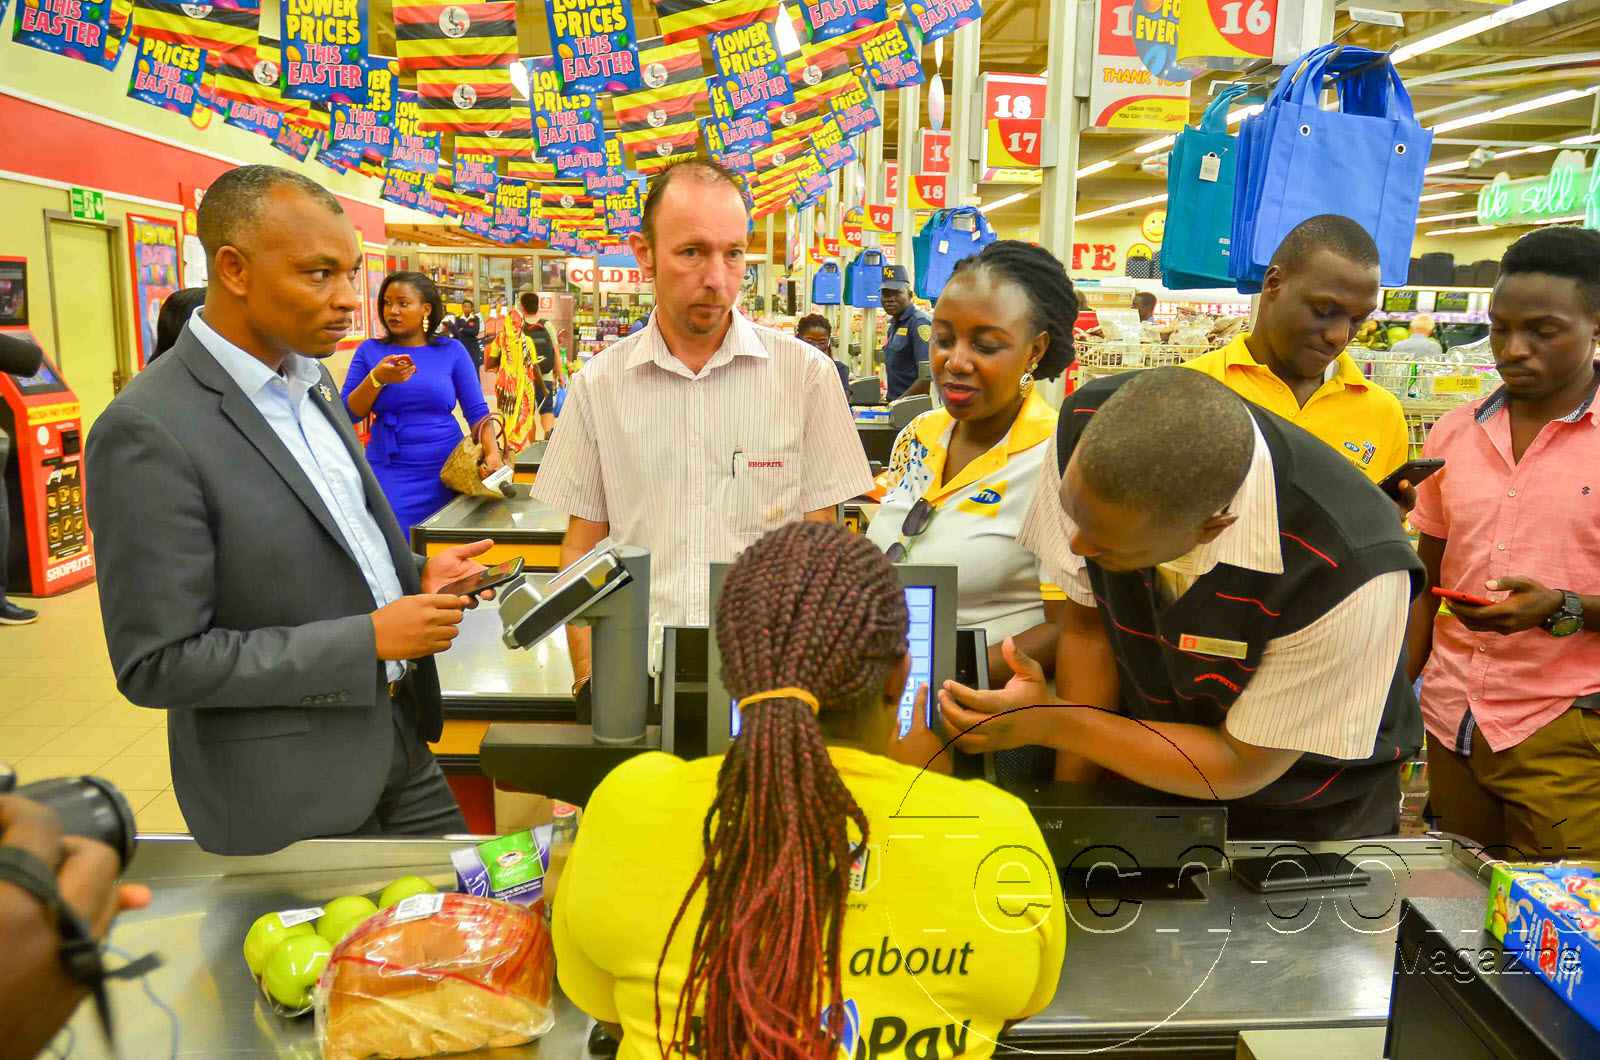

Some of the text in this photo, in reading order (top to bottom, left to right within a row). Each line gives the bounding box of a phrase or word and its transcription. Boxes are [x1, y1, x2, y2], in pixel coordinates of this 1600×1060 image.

[288, 0, 359, 18] LOWER
[1220, 1, 1271, 35] 16
[22, 6, 101, 48] EASTER
[286, 14, 361, 44] PRICES
[553, 6, 627, 37] PRICES
[575, 34, 612, 55] THIS
[715, 21, 771, 58] LOWER
[863, 37, 908, 65] PRICES
[142, 37, 201, 72] PRICES
[304, 43, 342, 64] THIS
[719, 42, 777, 76] PRICES
[153, 60, 181, 83] THIS
[287, 61, 363, 89] EASTER
[562, 51, 635, 82] EASTER
[738, 66, 768, 88] THIS
[876, 60, 919, 85] EASTER
[1103, 68, 1151, 85] THANK
[134, 71, 194, 104] EASTER
[730, 76, 789, 109] EASTER
[830, 88, 868, 112] PRICES
[993, 95, 1032, 120] 18
[349, 108, 376, 126] THIS
[549, 110, 578, 127] THIS
[334, 122, 391, 145] EASTER
[538, 122, 596, 147] EASTER
[721, 120, 768, 146] EASTER
[1008, 132, 1038, 154] 17
[557, 152, 603, 170] EASTER
[496, 194, 528, 208] PRICES
[497, 184, 528, 197] LOWER
[922, 185, 944, 200] 18
[1477, 182, 1509, 219] We
[1520, 167, 1577, 214] sell
[873, 214, 890, 225] 19
[847, 231, 861, 241] 20
[570, 269, 623, 283] COLD
[849, 936, 974, 976] about
